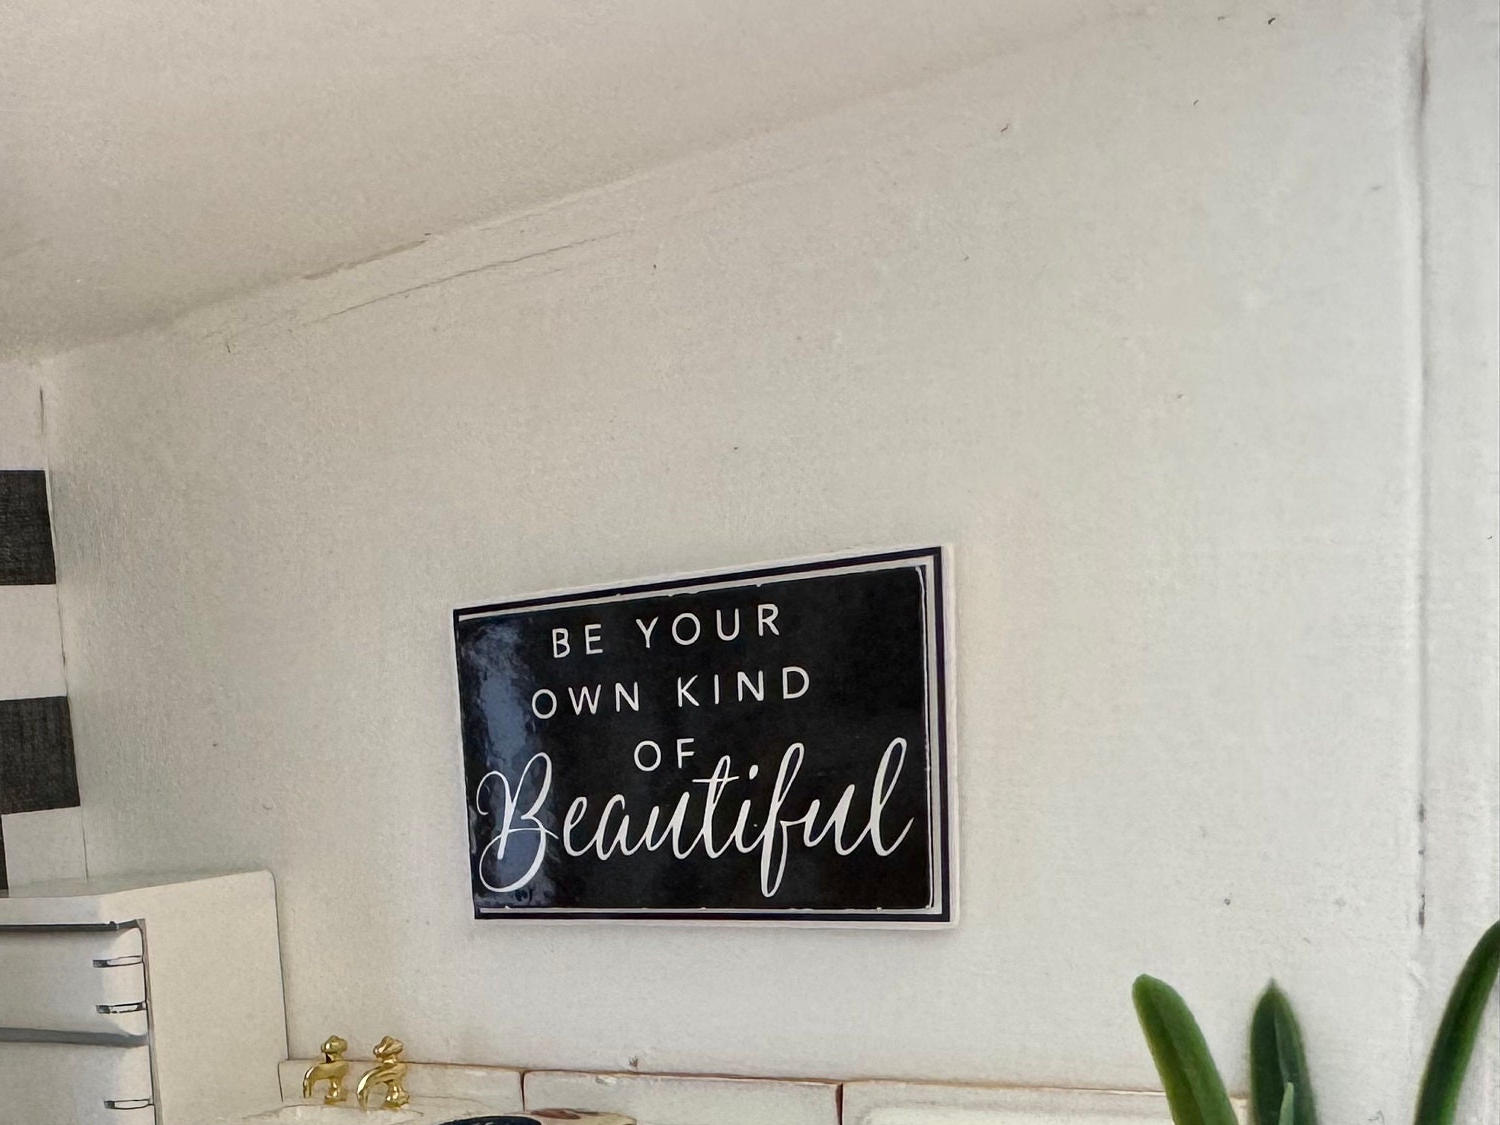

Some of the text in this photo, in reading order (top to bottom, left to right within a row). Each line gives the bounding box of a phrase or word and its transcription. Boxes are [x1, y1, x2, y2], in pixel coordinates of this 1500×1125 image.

[552, 603, 780, 658] BE YOUR
[531, 666, 810, 719] OWN KIND
[633, 738, 695, 771] OF
[476, 737, 914, 897] Beautiful
